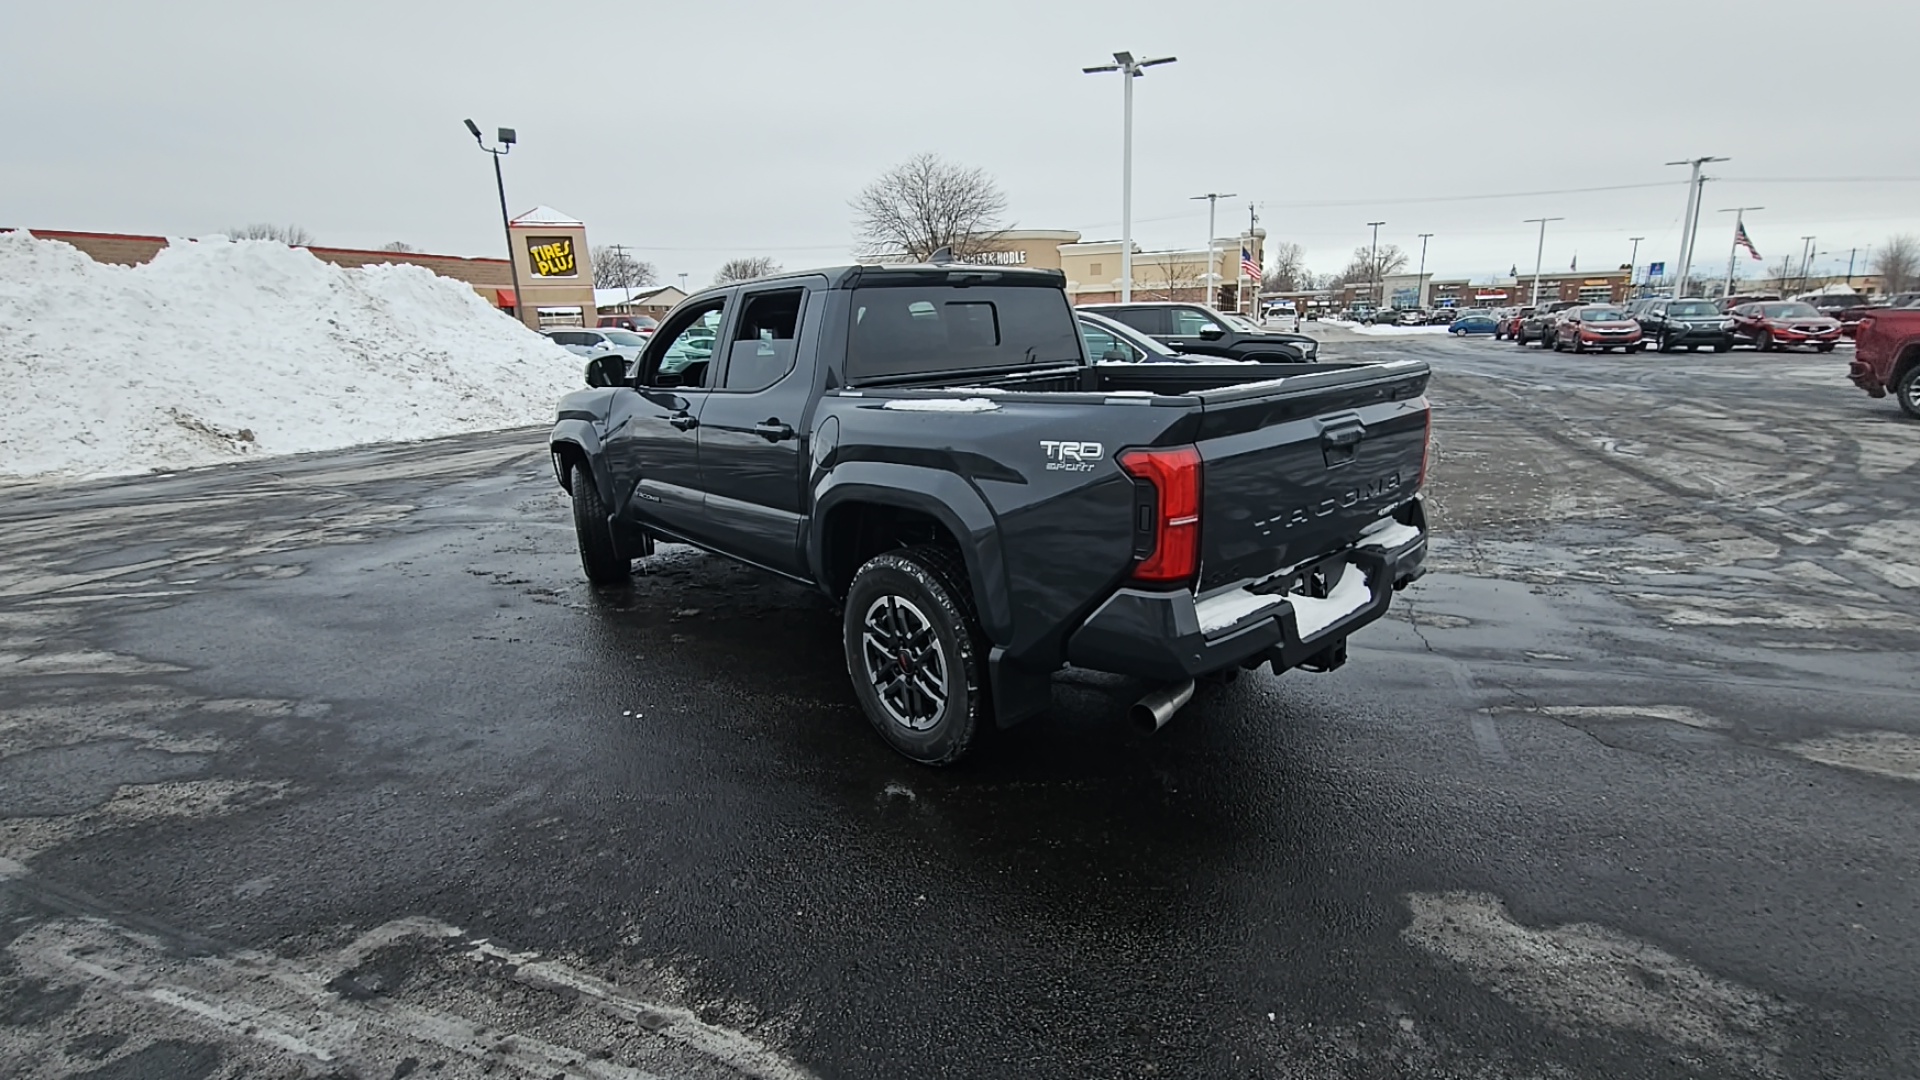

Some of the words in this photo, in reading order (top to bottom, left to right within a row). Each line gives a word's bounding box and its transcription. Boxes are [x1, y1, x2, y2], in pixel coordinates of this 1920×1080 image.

[530, 240, 570, 262] TIRES
[997, 251, 1026, 264] NOBLE
[538, 254, 573, 275] PLUS
[1040, 440, 1103, 461] TRD
[1253, 472, 1401, 536] TACOMA
